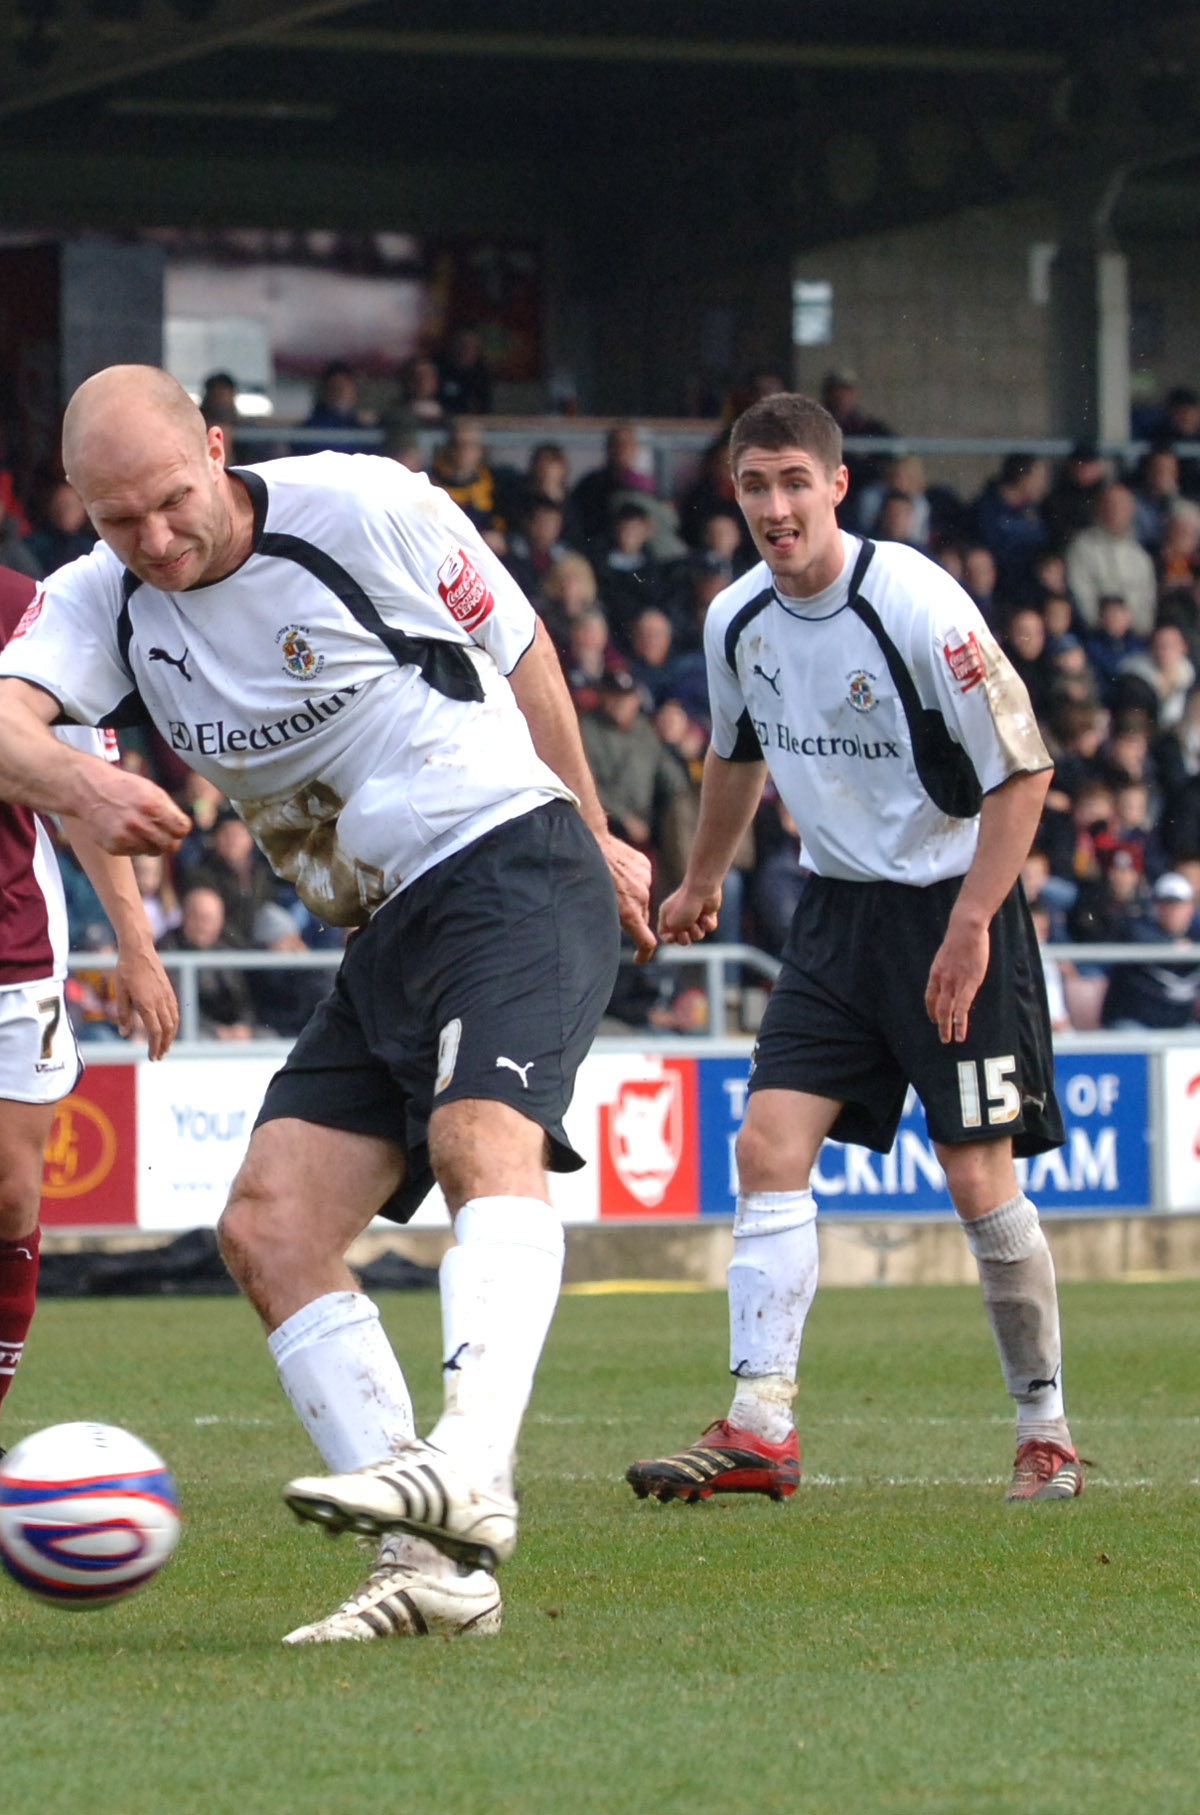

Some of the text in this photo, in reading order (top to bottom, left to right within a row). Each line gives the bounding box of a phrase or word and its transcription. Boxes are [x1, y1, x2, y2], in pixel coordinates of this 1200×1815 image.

[195, 684, 360, 756] Electrolux
[776, 722, 900, 760] Electrolux
[36, 995, 62, 1060] 7
[957, 1054, 1021, 1128] 15
[1066, 1073, 1120, 1117] OF
